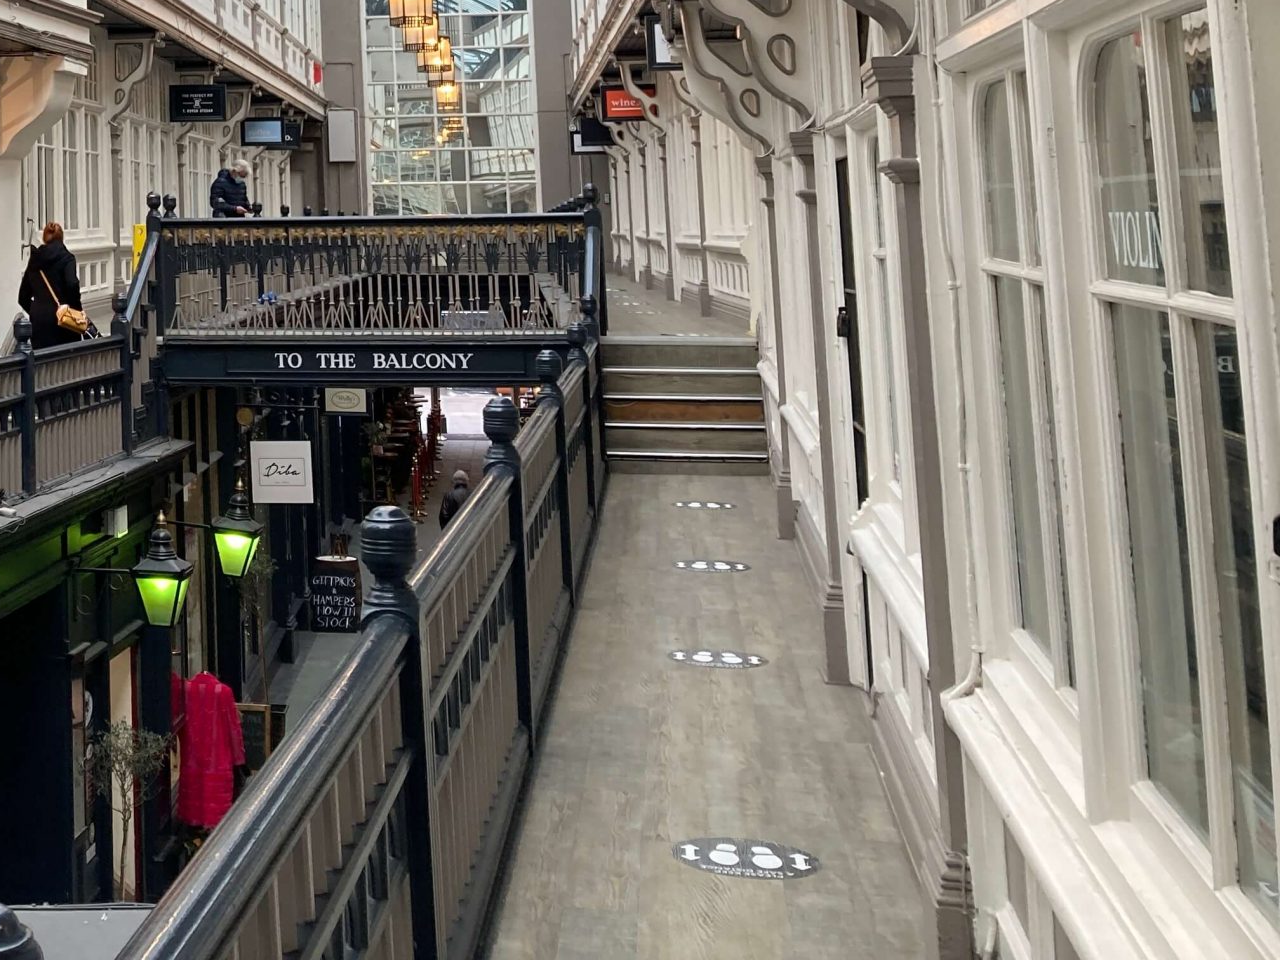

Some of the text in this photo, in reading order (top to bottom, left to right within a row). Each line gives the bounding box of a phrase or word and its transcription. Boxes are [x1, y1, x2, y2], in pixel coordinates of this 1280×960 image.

[274, 352, 474, 369] TO THE BALCONY
[313, 594, 355, 607] HAMPERS
[317, 617, 353, 629] STOCK
